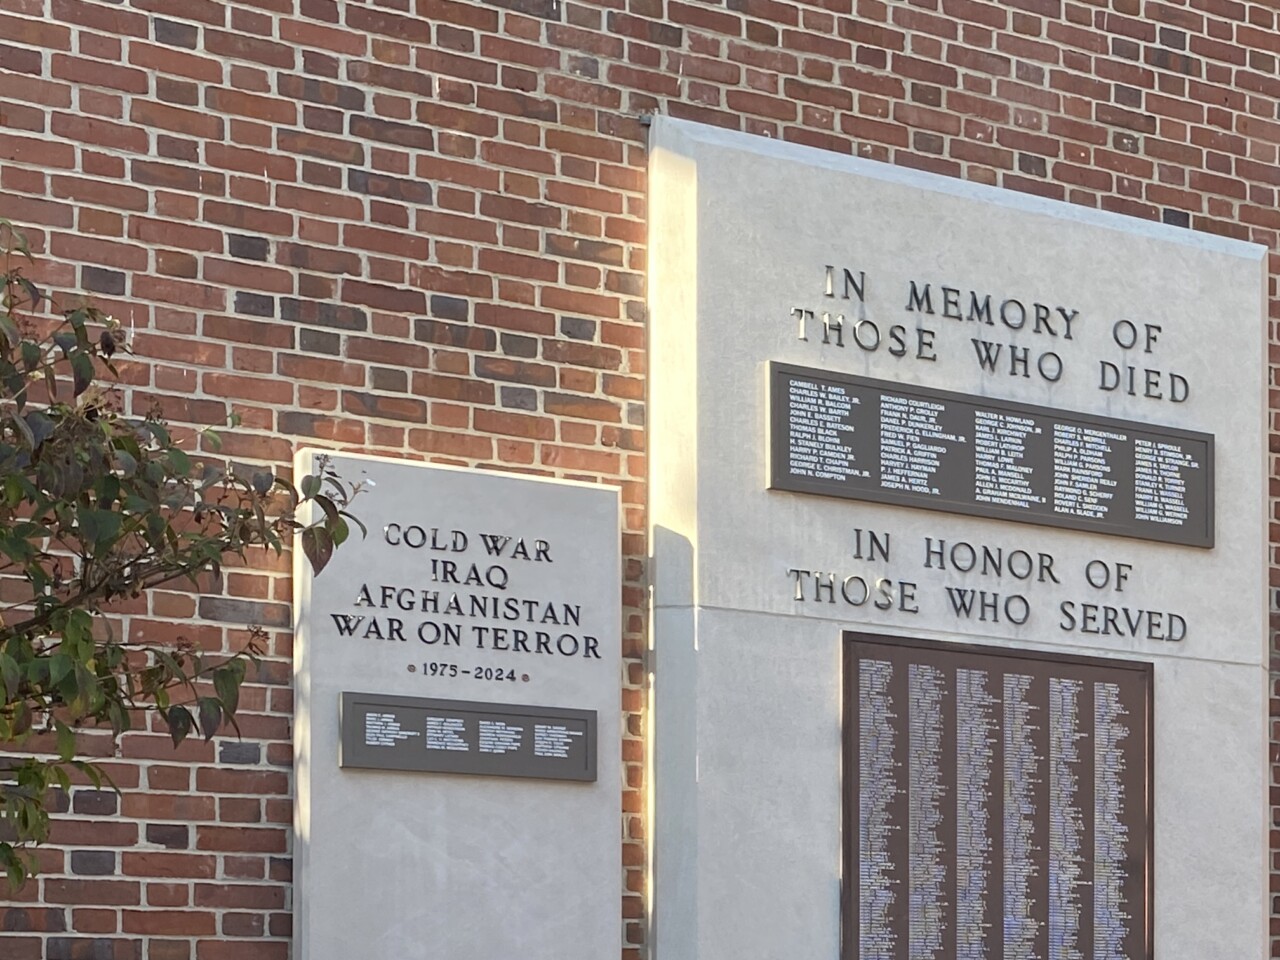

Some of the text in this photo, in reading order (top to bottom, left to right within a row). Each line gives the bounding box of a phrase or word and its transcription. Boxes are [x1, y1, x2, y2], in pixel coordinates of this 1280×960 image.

[824, 265, 1162, 353] IN MEMORY OF
[790, 306, 1190, 402] THOSE WHO DIED
[383, 523, 553, 563] COLD WAR
[853, 528, 1133, 592] IN HONOR OF
[431, 559, 508, 590] IRAQ
[353, 583, 581, 627] AFGHANISTAN
[786, 568, 1187, 642] THOSE WHO SERVED
[330, 614, 602, 659] WAR ON TERROR
